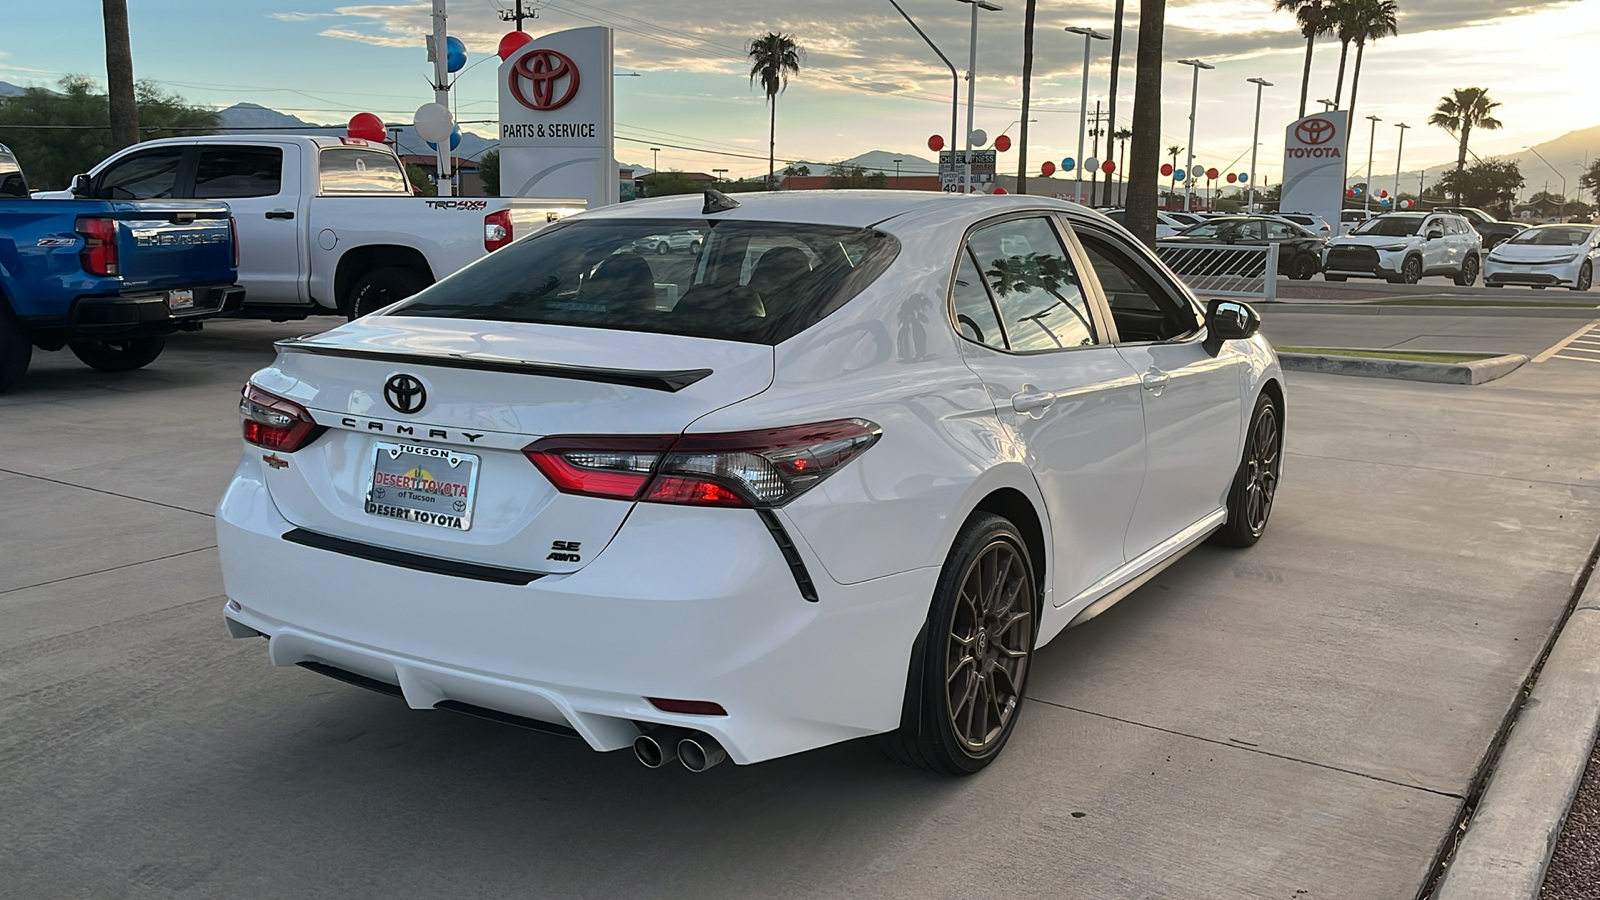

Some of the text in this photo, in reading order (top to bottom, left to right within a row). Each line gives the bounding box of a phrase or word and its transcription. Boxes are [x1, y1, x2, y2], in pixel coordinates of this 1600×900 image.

[503, 123, 595, 138] PARTS & SERVICE
[940, 155, 994, 163] CHZE TNESS
[1287, 147, 1341, 159] TOYOTA
[943, 184, 957, 192] 40
[137, 233, 228, 247] CHEVROLET
[341, 417, 484, 442] CAMRY
[399, 444, 449, 458] TUCSON
[375, 471, 468, 498] DESERT TOYOTA
[409, 492, 436, 503] Tucson
[369, 503, 462, 529] DESERT TOYOTA
[551, 540, 581, 552] SE
[546, 552, 581, 563] AWD
